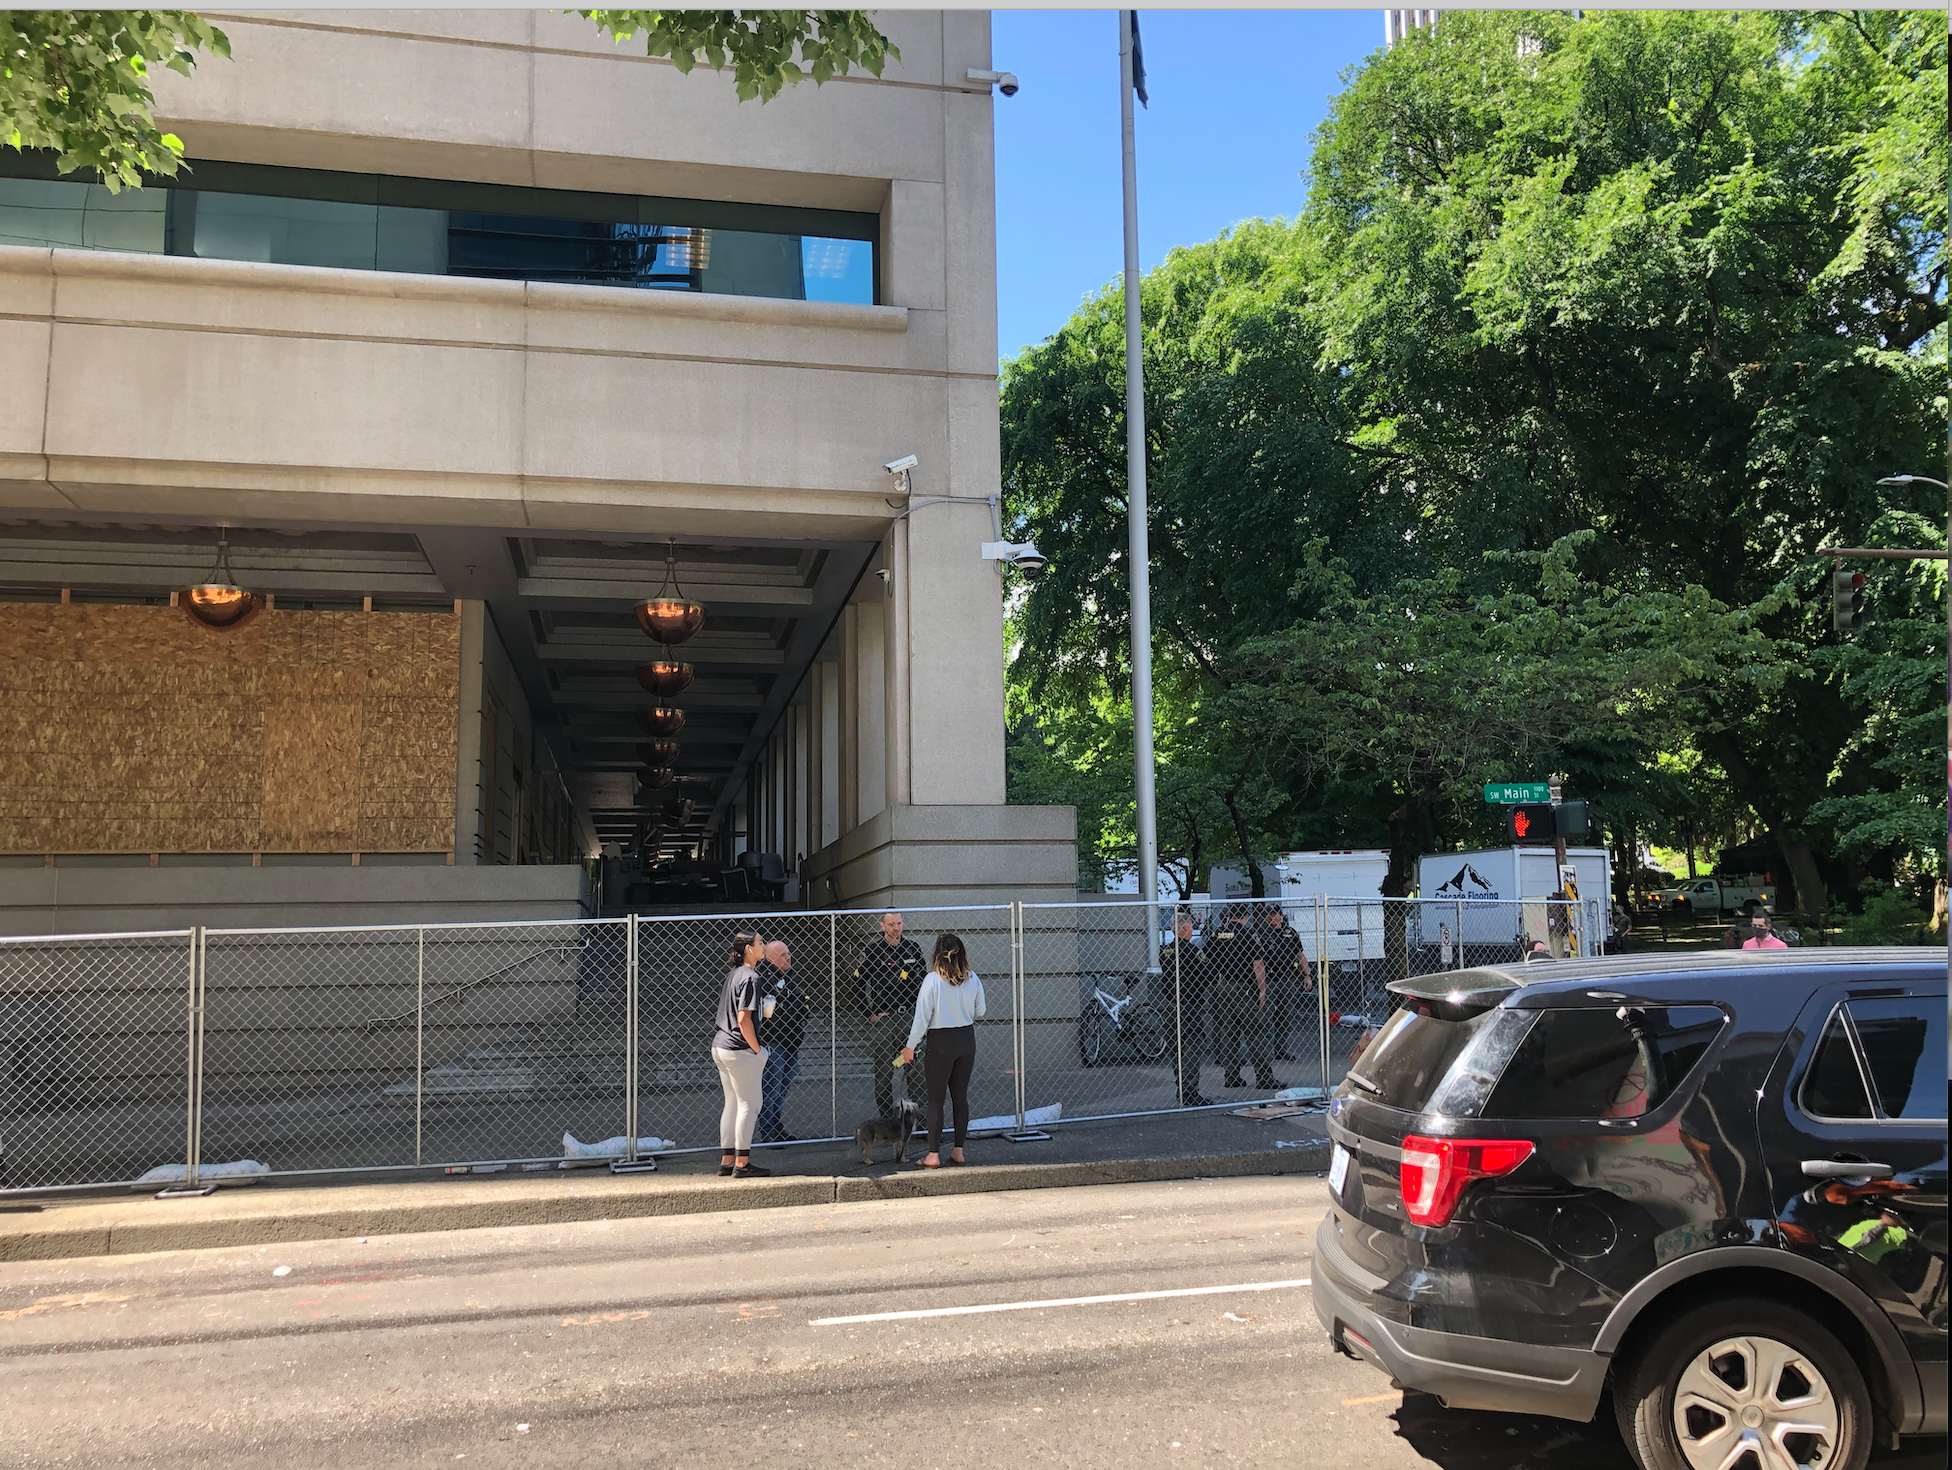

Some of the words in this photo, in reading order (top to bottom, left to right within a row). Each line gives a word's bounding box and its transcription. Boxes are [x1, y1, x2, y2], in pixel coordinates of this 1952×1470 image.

[1490, 791, 1499, 799] SW
[1504, 787, 1530, 798] Main
[1468, 891, 1499, 900] Flooring
